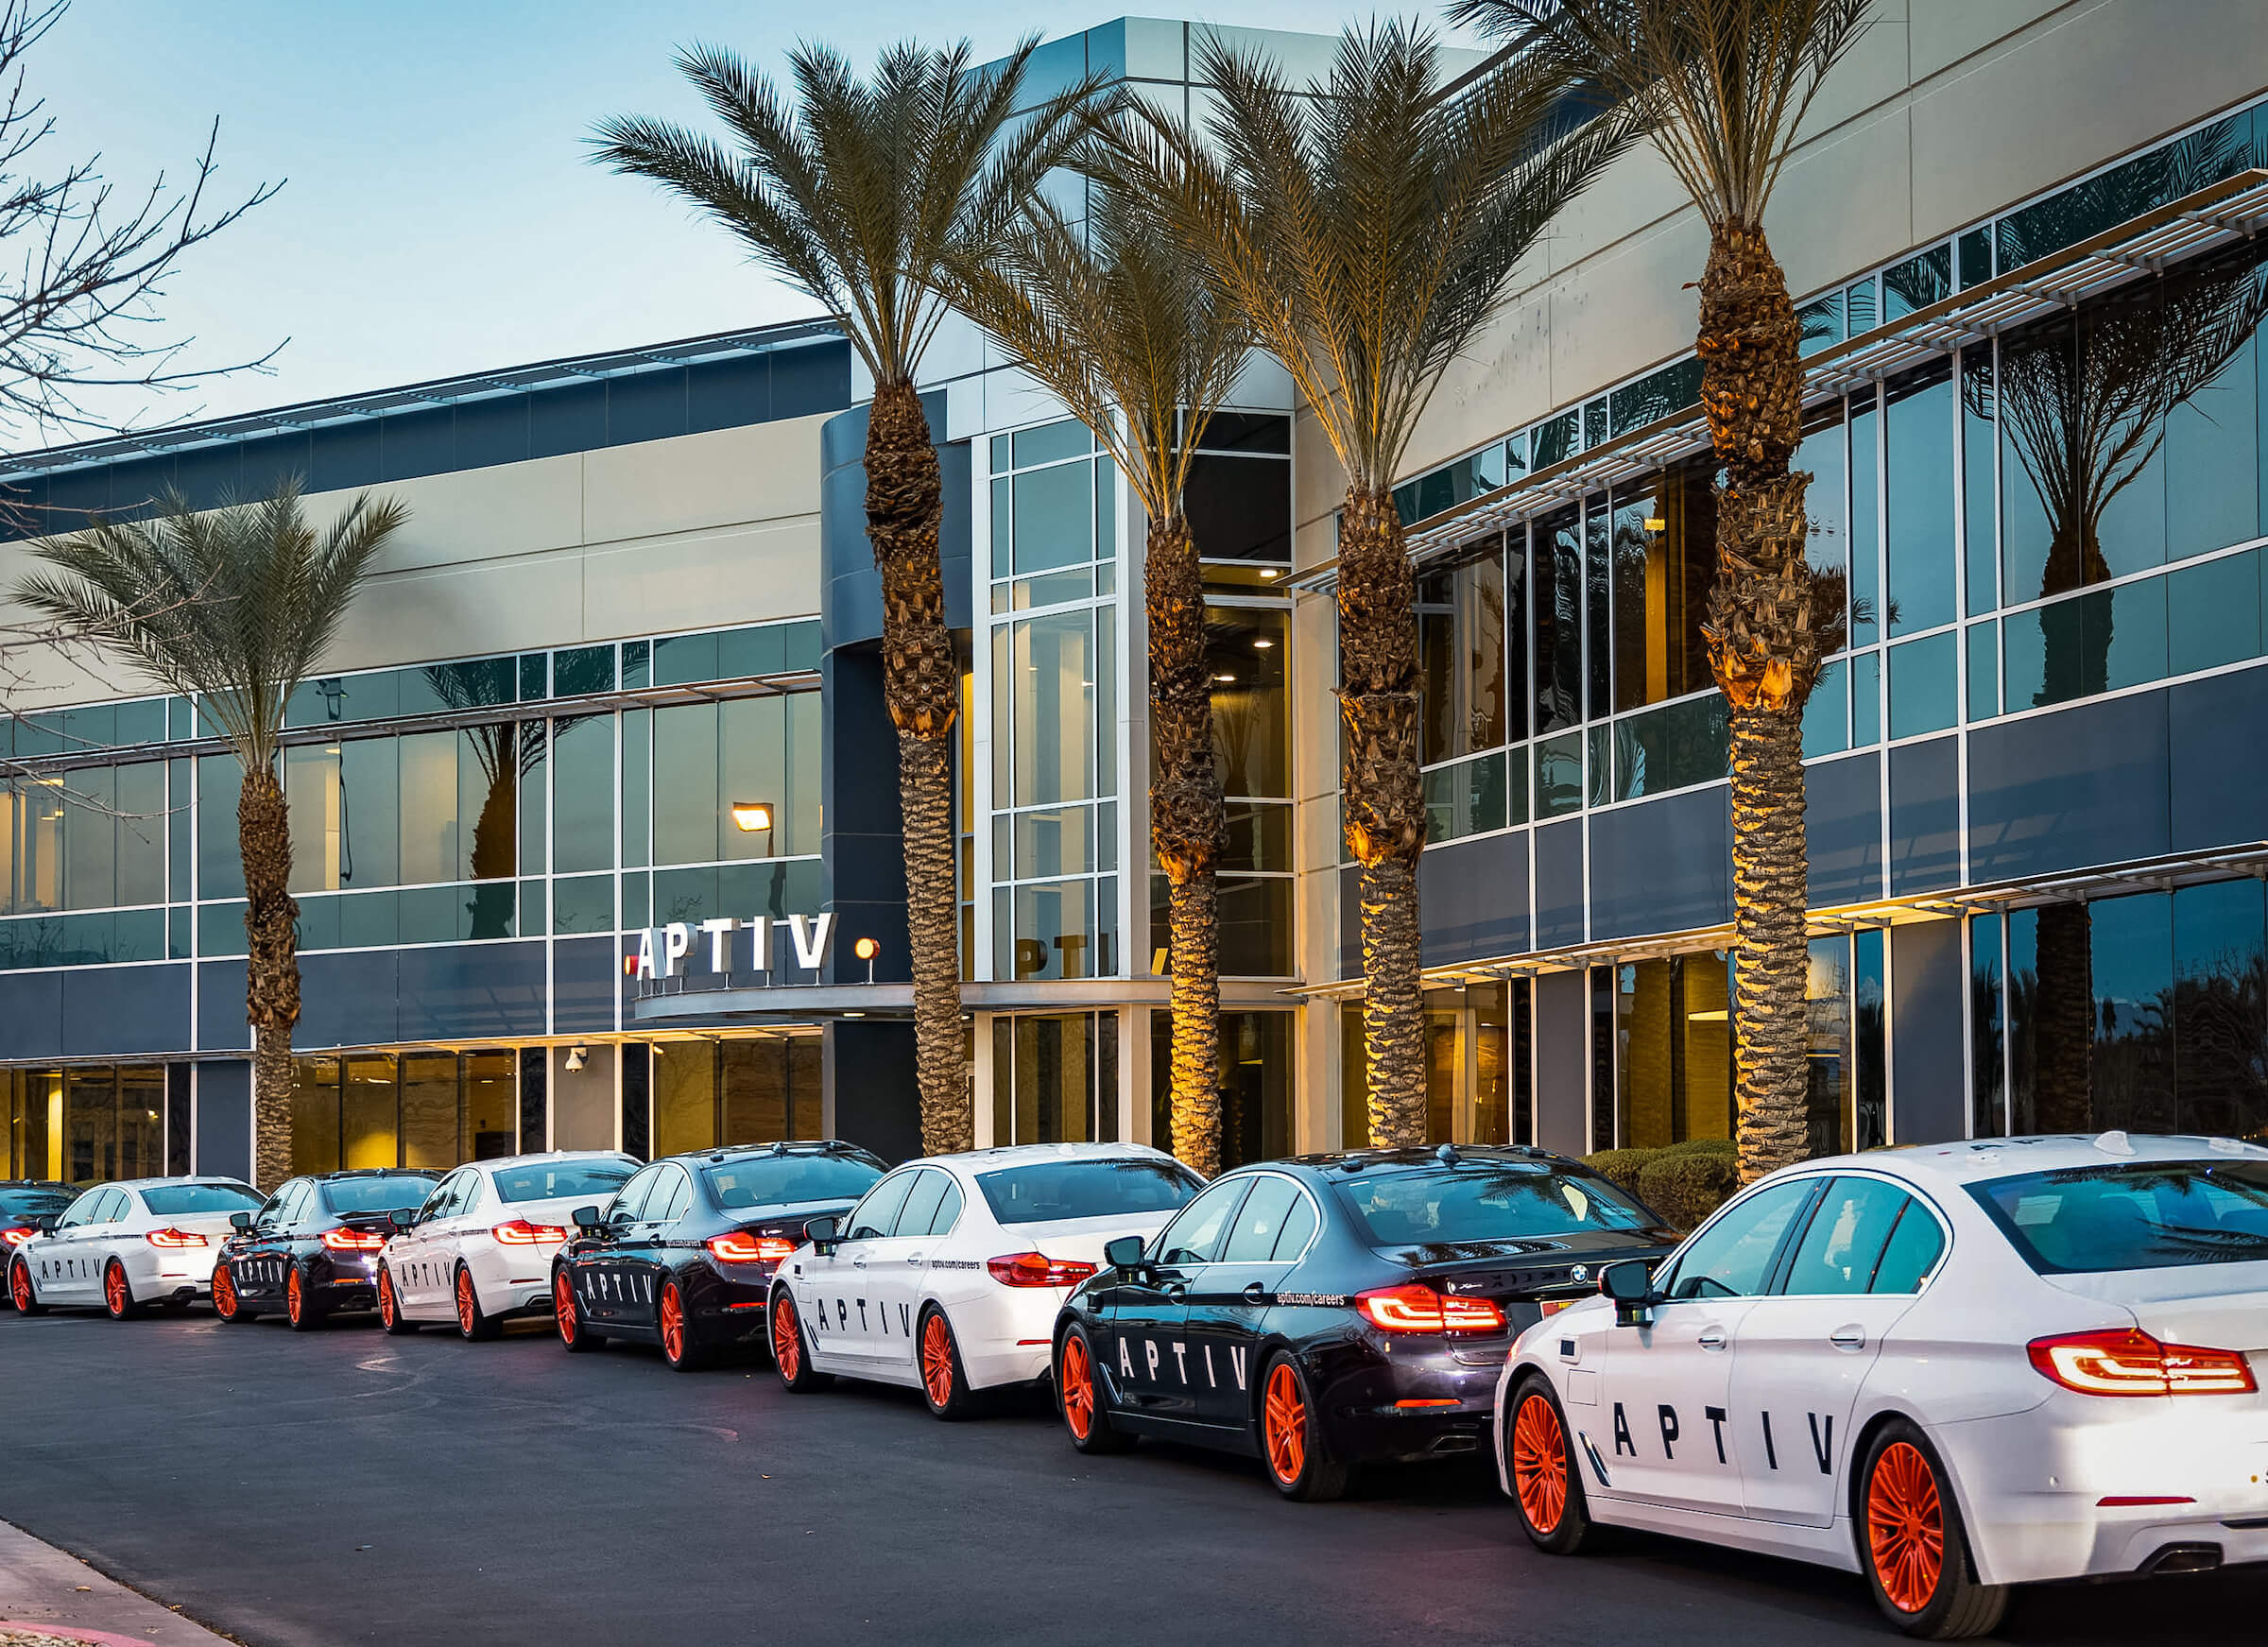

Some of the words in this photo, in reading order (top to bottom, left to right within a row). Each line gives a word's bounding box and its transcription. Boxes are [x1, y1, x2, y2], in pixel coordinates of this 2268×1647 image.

[637, 912, 838, 981] APTIV
[42, 1259, 100, 1278] APTIV
[238, 1261, 283, 1283] APTIV
[402, 1261, 451, 1287] APTIV
[586, 1272, 653, 1304] APTIV
[1277, 1290, 1346, 1306] aptiv.com/careers
[817, 1298, 910, 1338] APTIV
[1119, 1336, 1246, 1391] APTIV
[1613, 1402, 1833, 1476] APTIV
